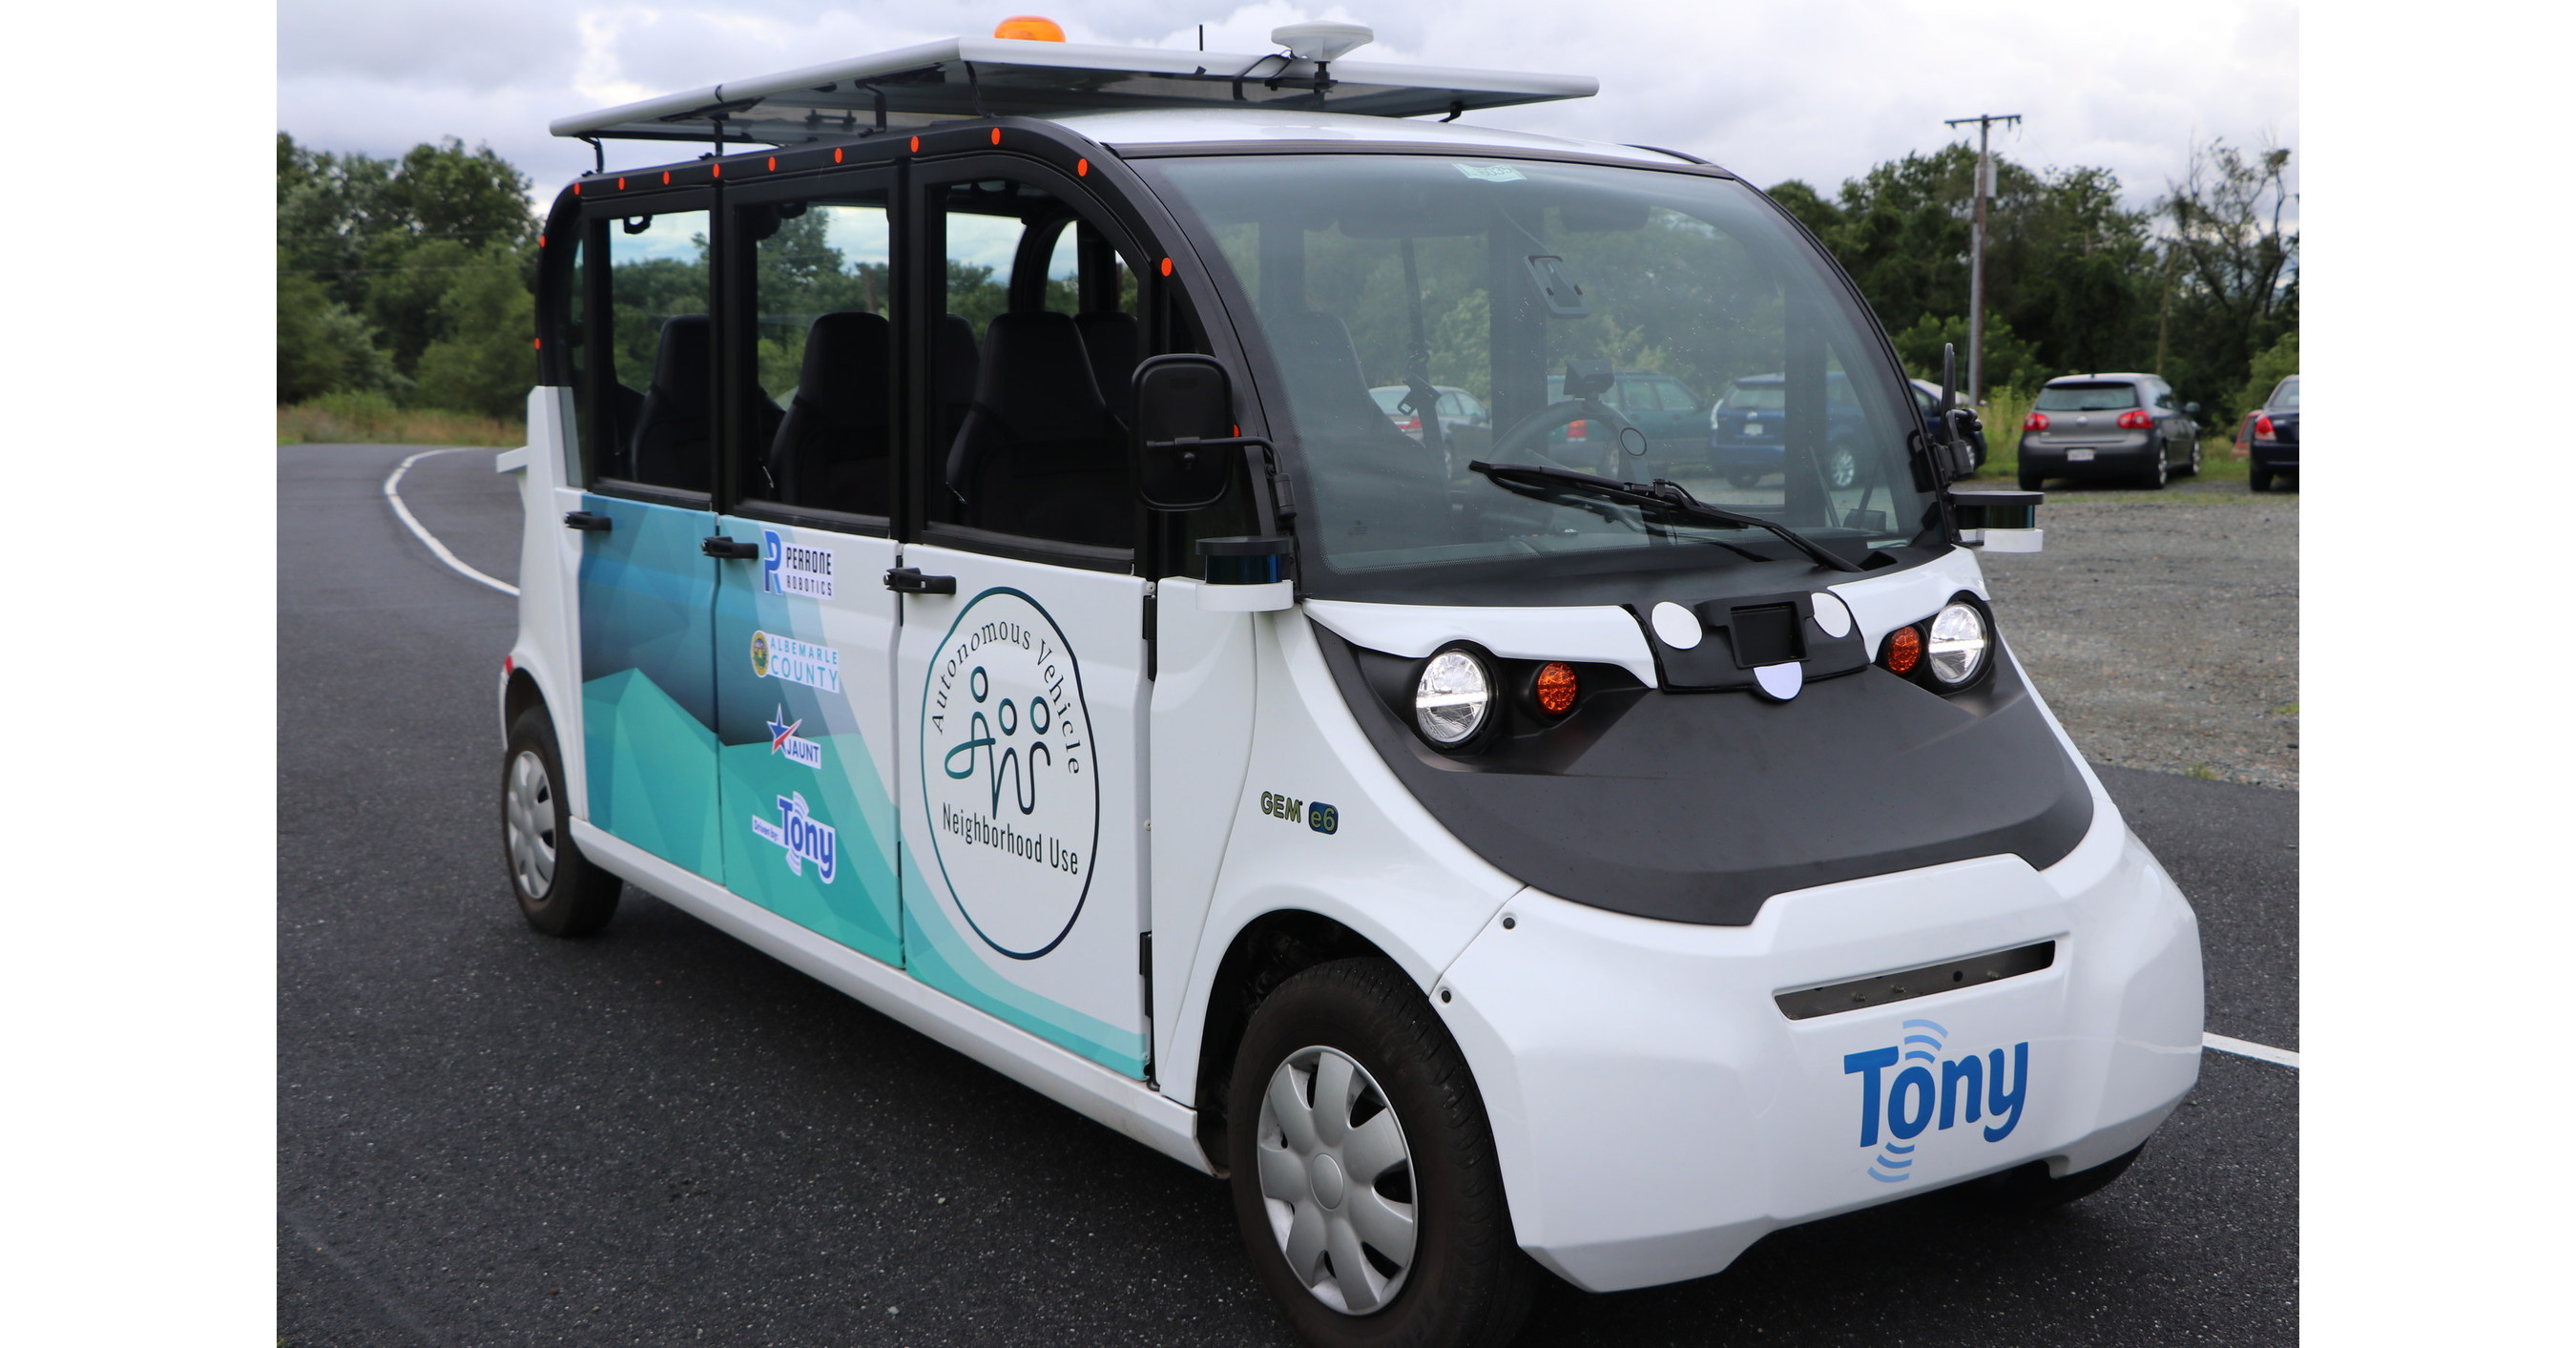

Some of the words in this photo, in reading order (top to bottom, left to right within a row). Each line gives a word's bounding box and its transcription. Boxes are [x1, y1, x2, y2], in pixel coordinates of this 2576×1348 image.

[786, 547, 832, 575] PERRONE
[786, 575, 832, 596] ROBOTICS
[771, 637, 838, 665] ALBEMARLE
[771, 654, 838, 691] COUNTY
[931, 620, 1031, 736] Autonomous
[1036, 638, 1080, 775] Vehicle
[786, 739, 820, 763] JAUNT
[1260, 791, 1301, 823] GEM
[1310, 807, 1336, 832] e6
[779, 798, 833, 879] Tony
[943, 801, 1043, 863] Neighborhood
[1049, 837, 1078, 875] Use
[1843, 1041, 2028, 1148] Tony
